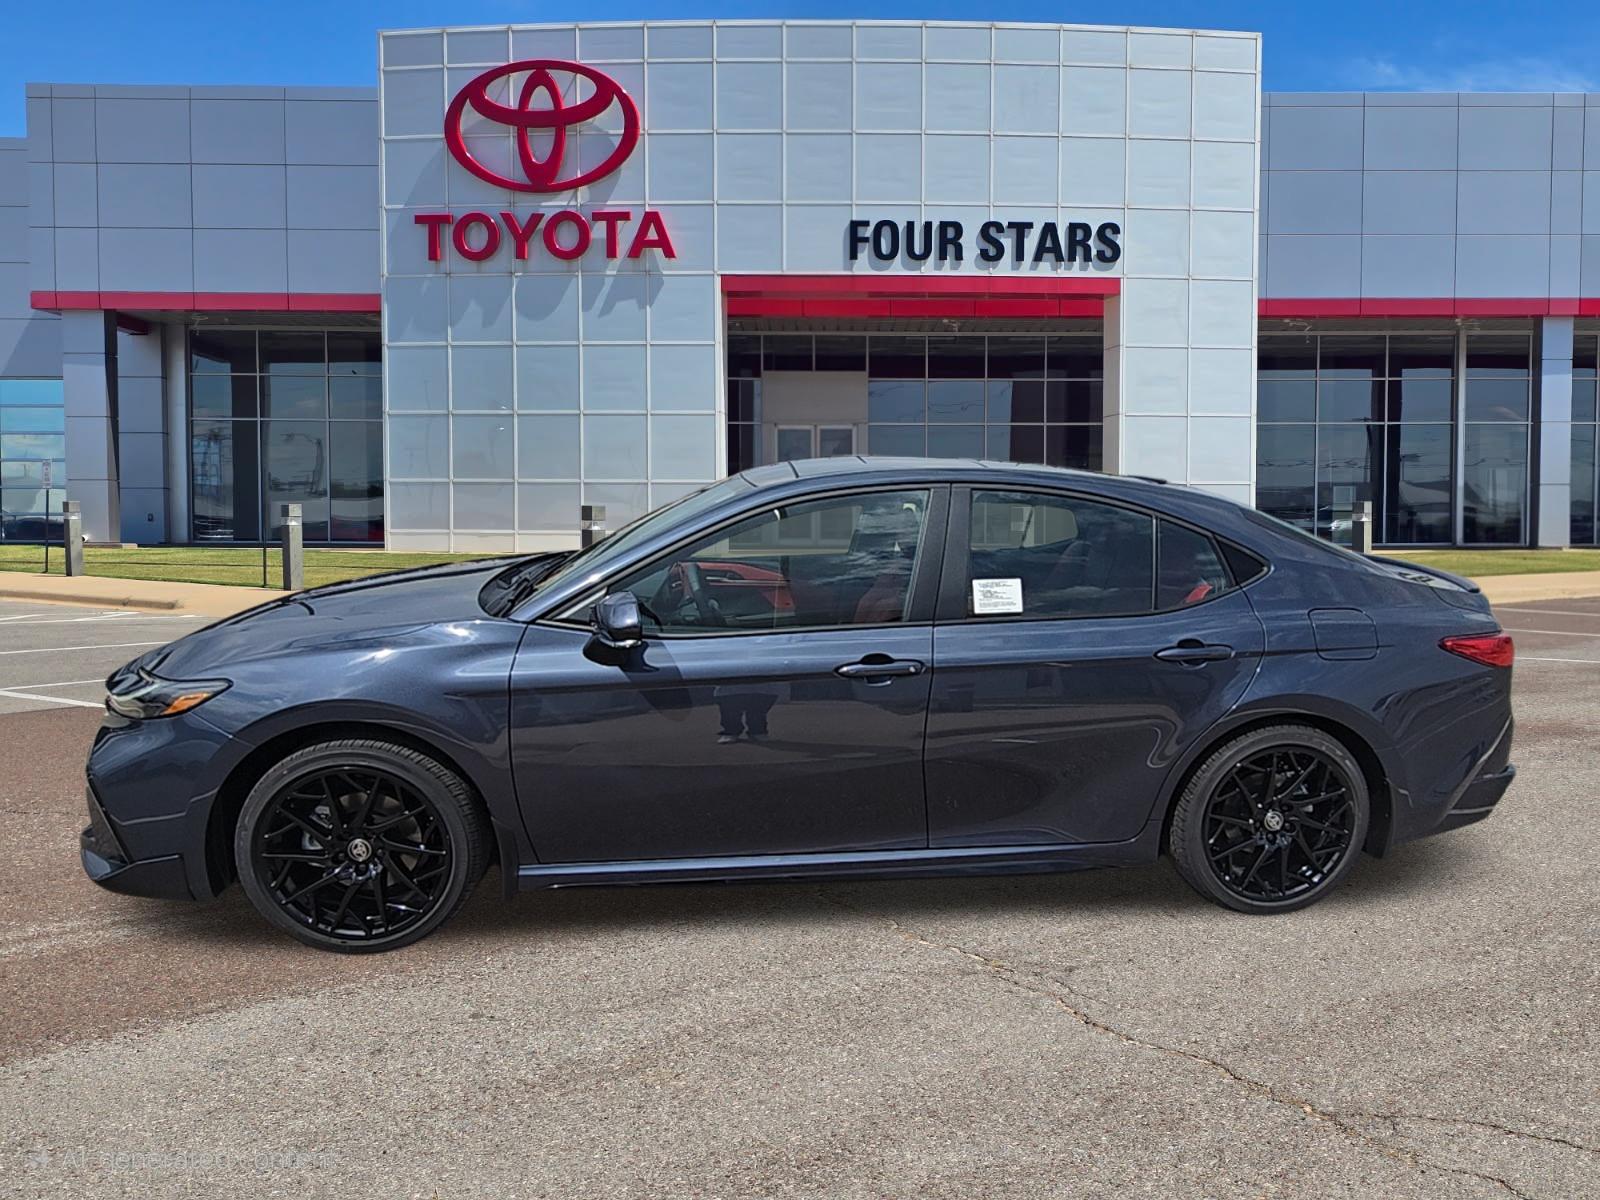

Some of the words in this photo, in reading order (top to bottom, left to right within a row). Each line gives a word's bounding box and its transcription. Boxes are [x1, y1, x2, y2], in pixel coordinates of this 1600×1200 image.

[414, 210, 676, 261] TOYOTA
[849, 219, 964, 261] FOUR
[979, 221, 1121, 263] STARS
